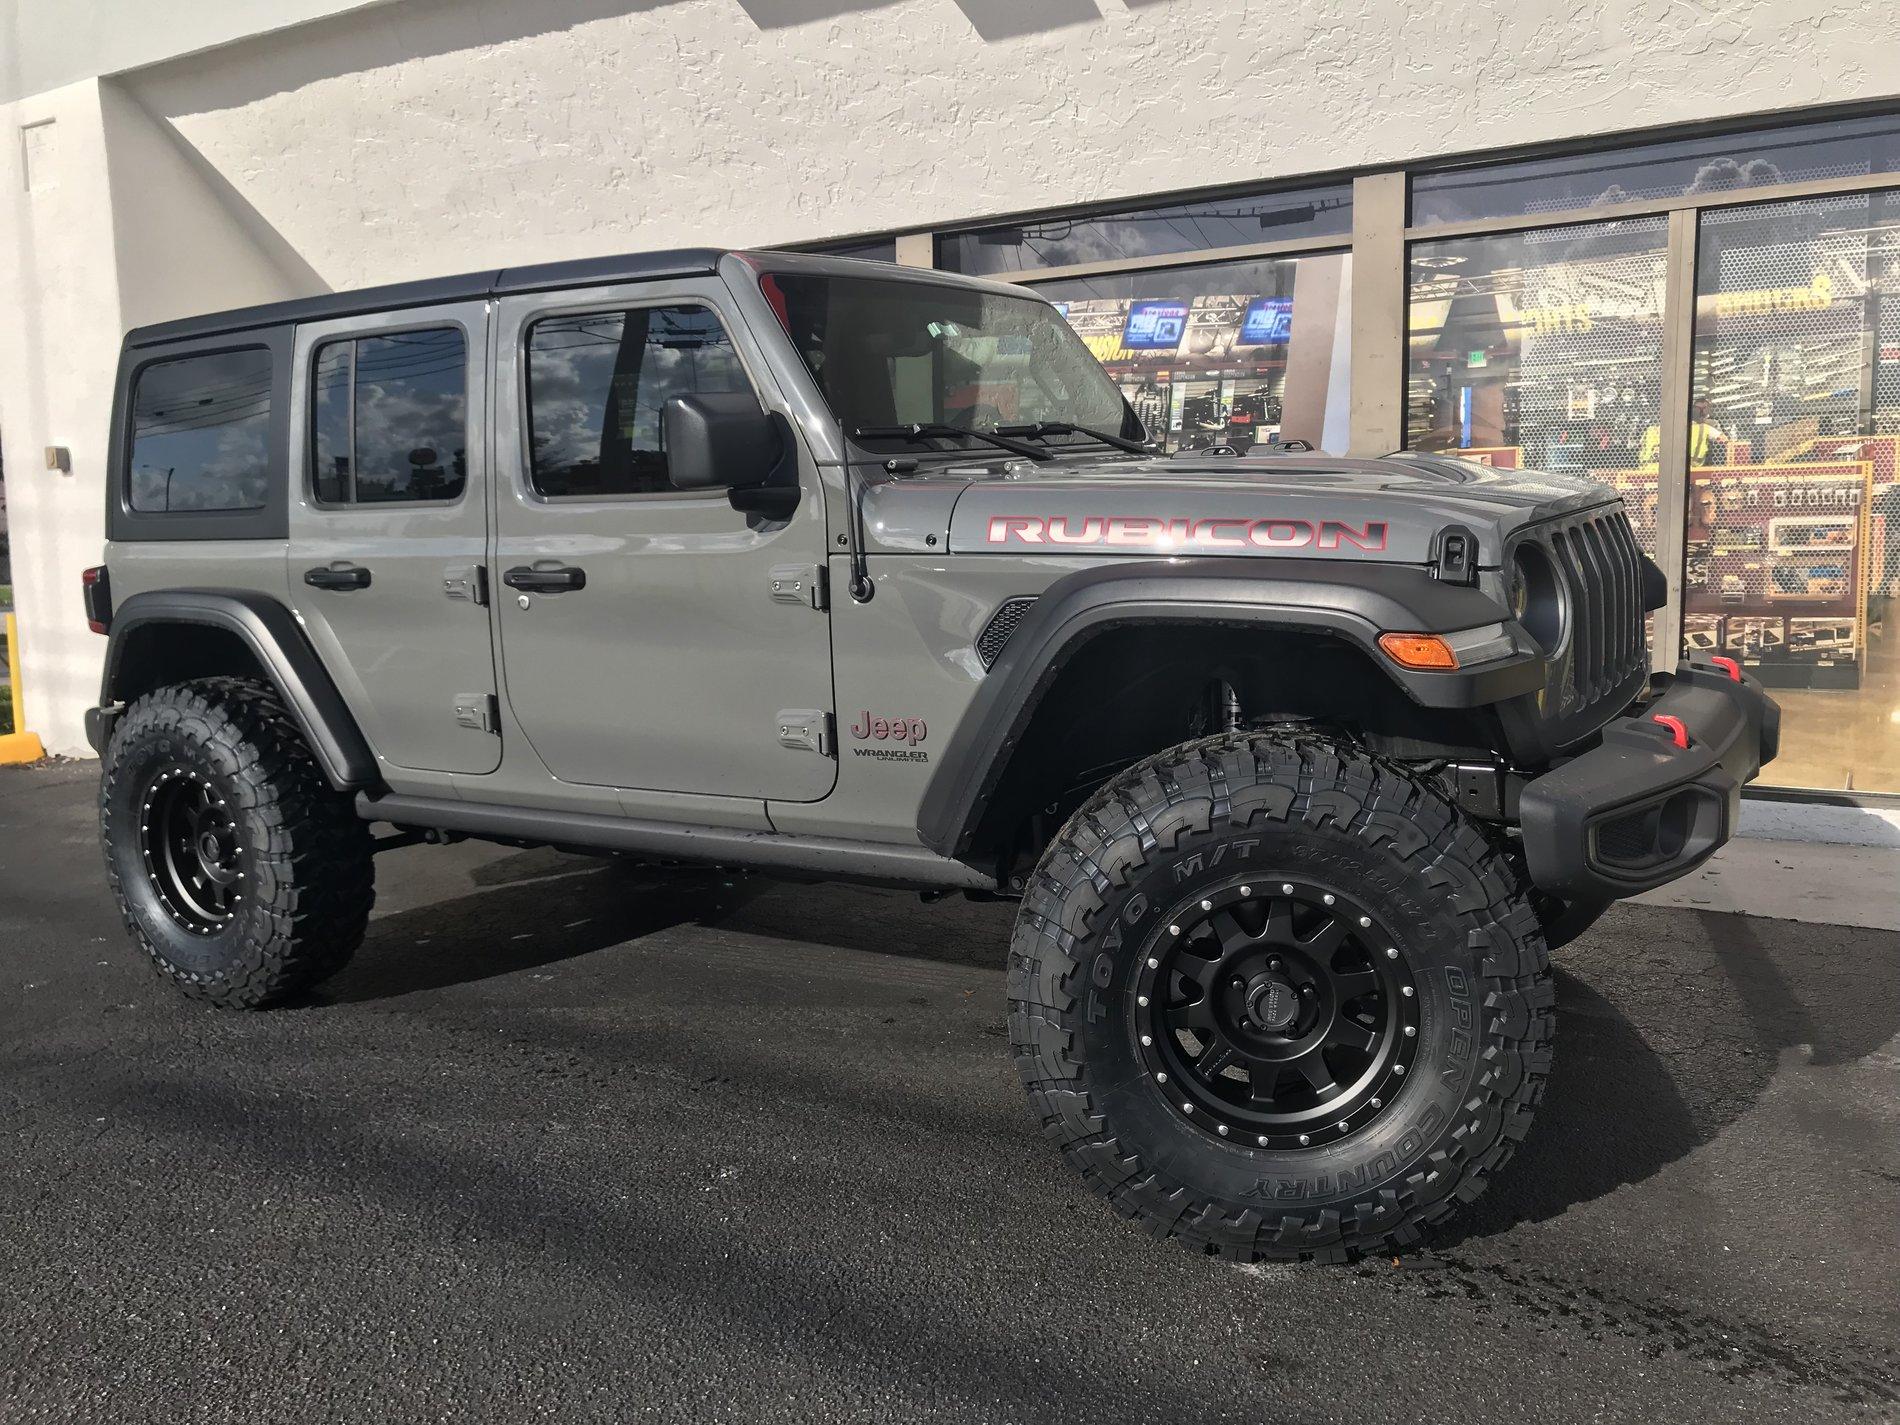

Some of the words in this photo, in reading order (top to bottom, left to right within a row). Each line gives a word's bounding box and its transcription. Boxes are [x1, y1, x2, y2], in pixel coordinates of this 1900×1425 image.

[987, 515, 1389, 551] RUBICON
[851, 711, 927, 746] Jeep
[853, 748, 927, 759] WRANGLER
[1173, 839, 1261, 882] M/T
[1088, 892, 1149, 1025] TOYO
[1440, 965, 1474, 1094] OPEN
[1238, 1101, 1446, 1201] COUNTRY
